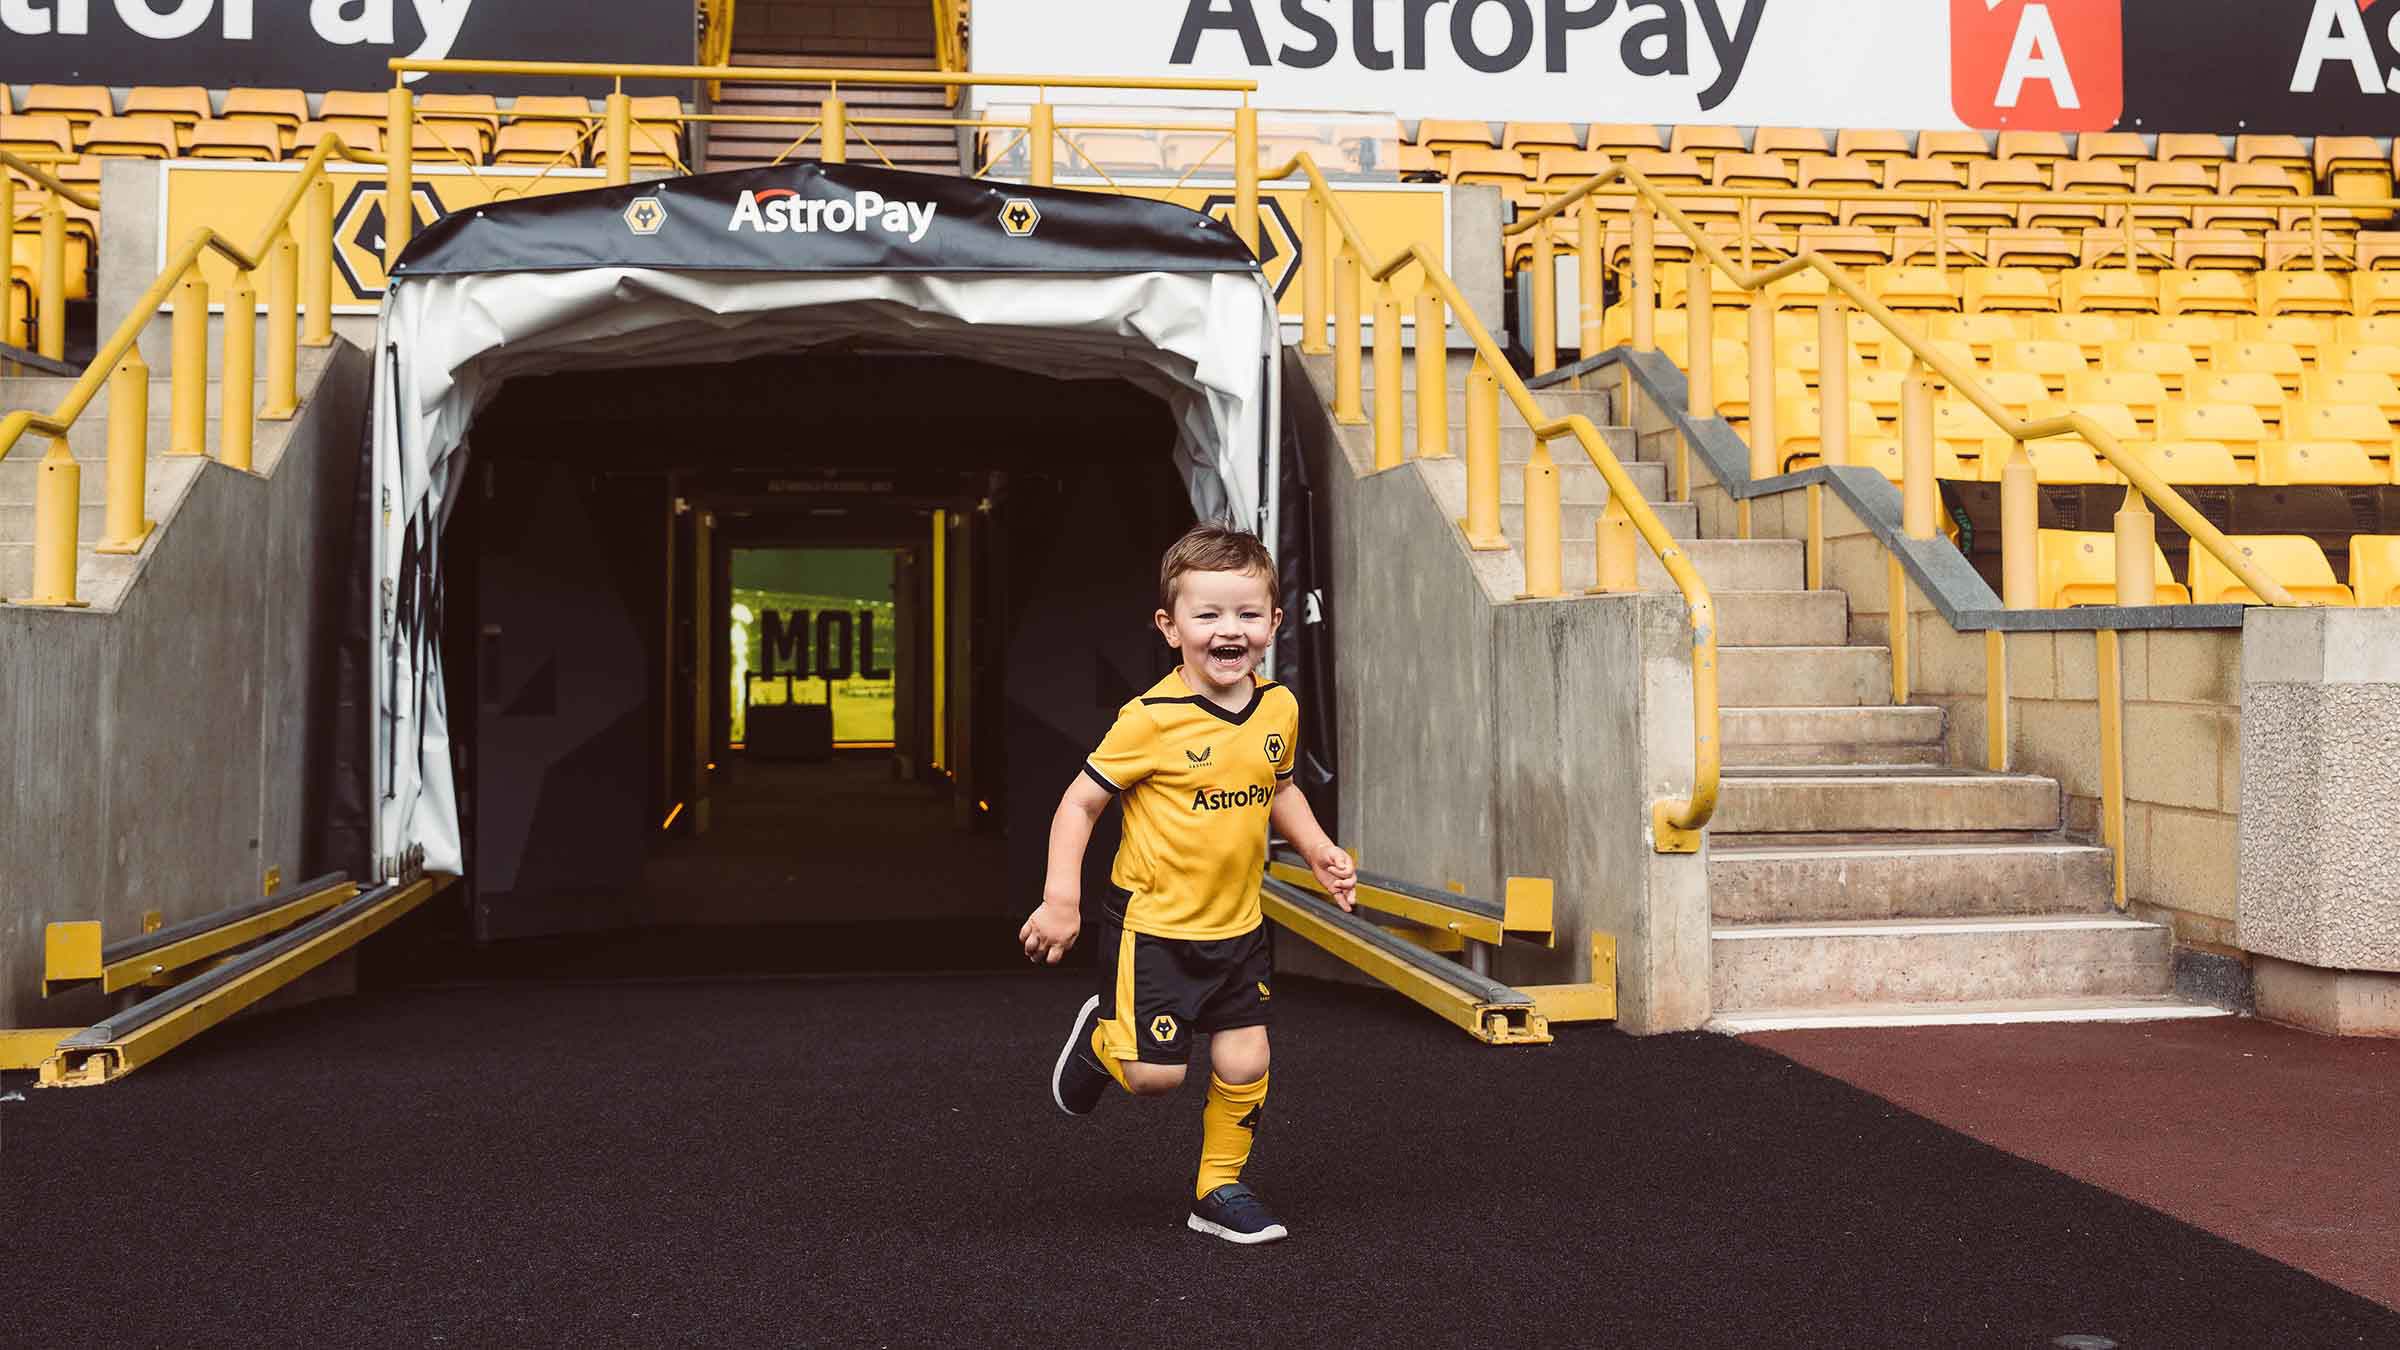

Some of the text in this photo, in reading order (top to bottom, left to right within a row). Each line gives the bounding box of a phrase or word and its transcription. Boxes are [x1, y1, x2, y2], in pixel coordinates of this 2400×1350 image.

[728, 188, 937, 243] AstroPay
[761, 609, 891, 681] MOL
[1192, 784, 1275, 811] AstroPay
